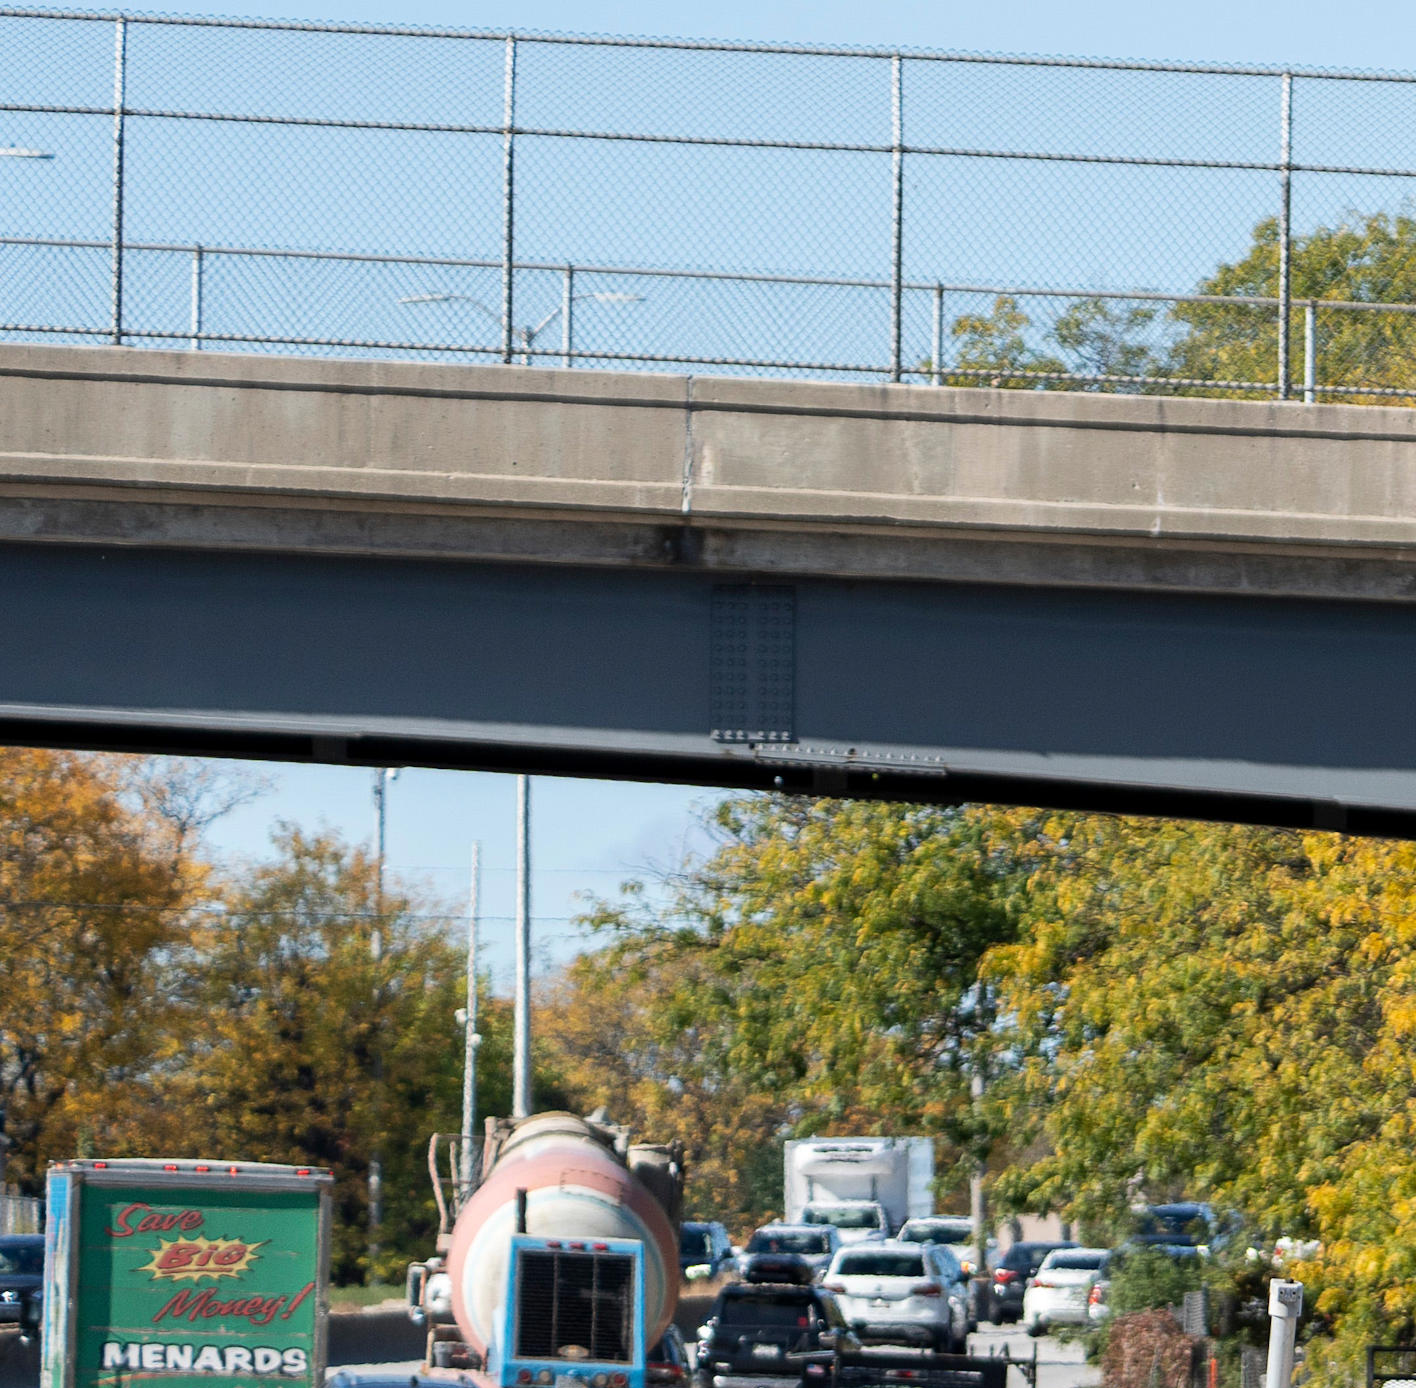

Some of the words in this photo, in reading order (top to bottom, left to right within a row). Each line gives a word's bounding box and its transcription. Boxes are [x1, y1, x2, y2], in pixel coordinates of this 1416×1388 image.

[105, 1202, 204, 1237] Save
[152, 1282, 314, 1325] Money!
[102, 1341, 308, 1373] MENARDS
